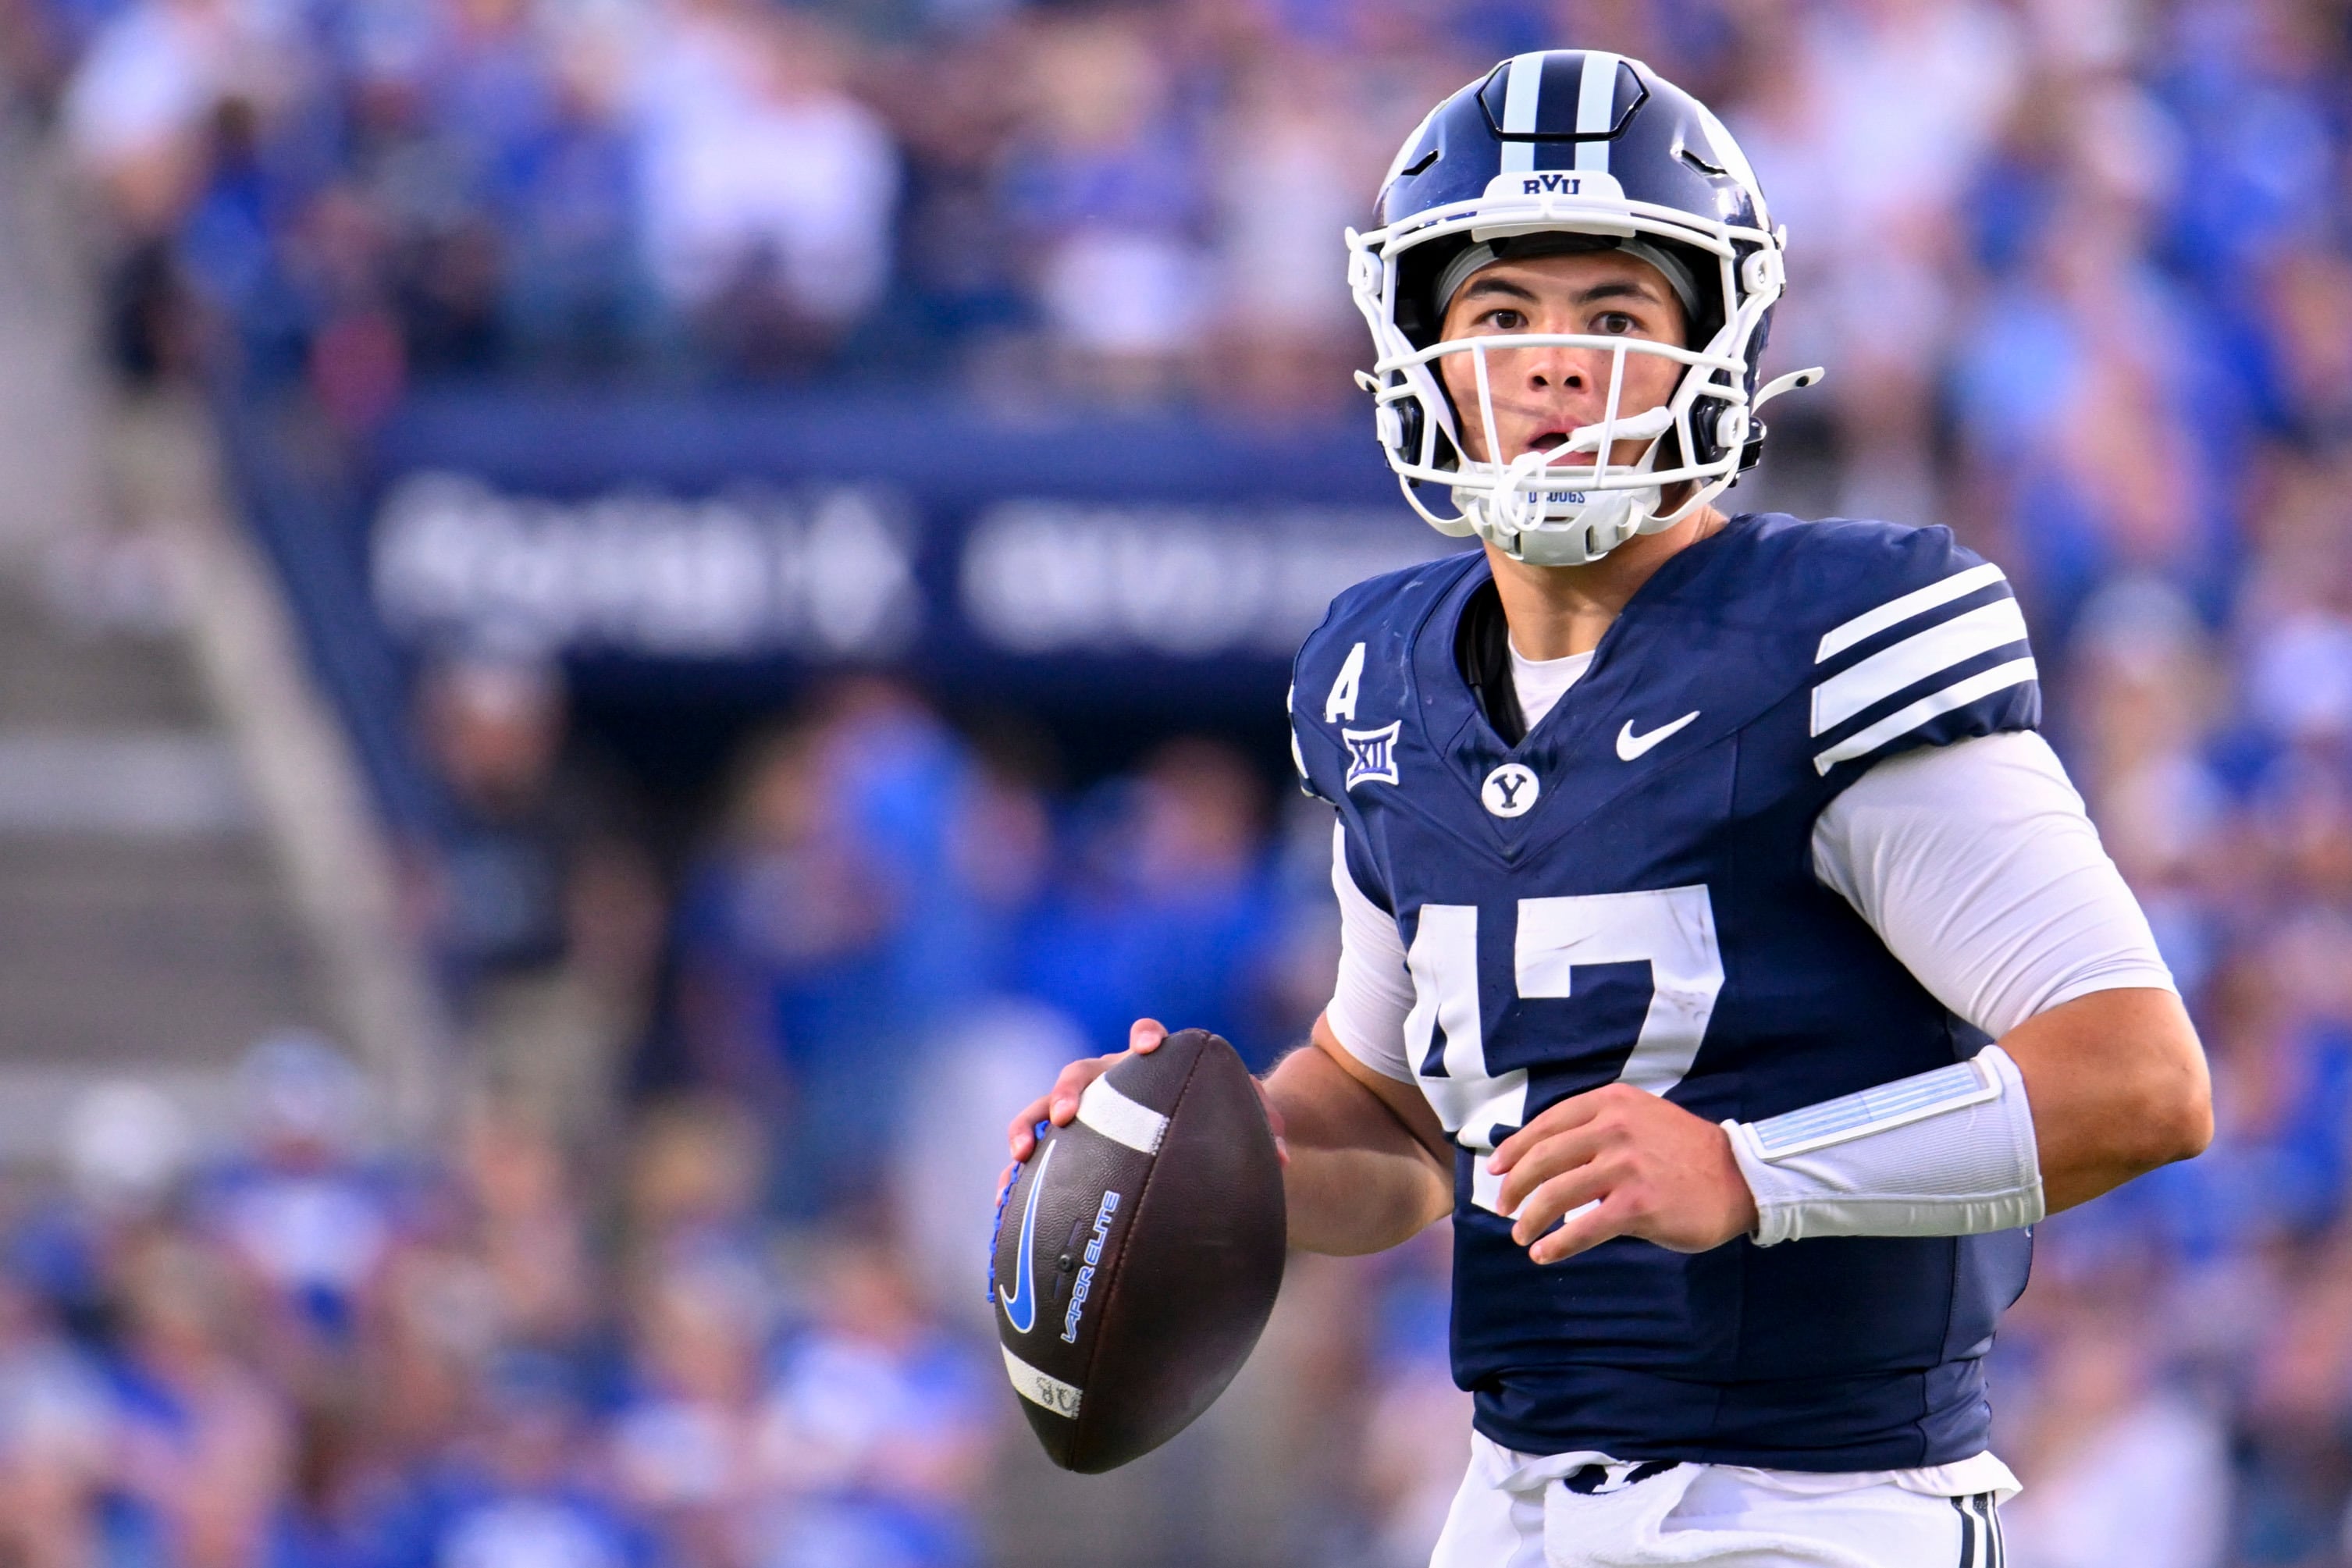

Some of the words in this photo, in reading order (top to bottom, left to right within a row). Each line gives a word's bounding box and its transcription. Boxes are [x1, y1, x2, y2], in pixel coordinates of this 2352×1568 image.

[1523, 174, 1581, 195] BYU
[1492, 773, 1528, 809] Y
[1404, 884, 1726, 1222] 47
[1060, 1265, 1095, 1343] VAPOR
[1083, 1190, 1120, 1266] ELITE
